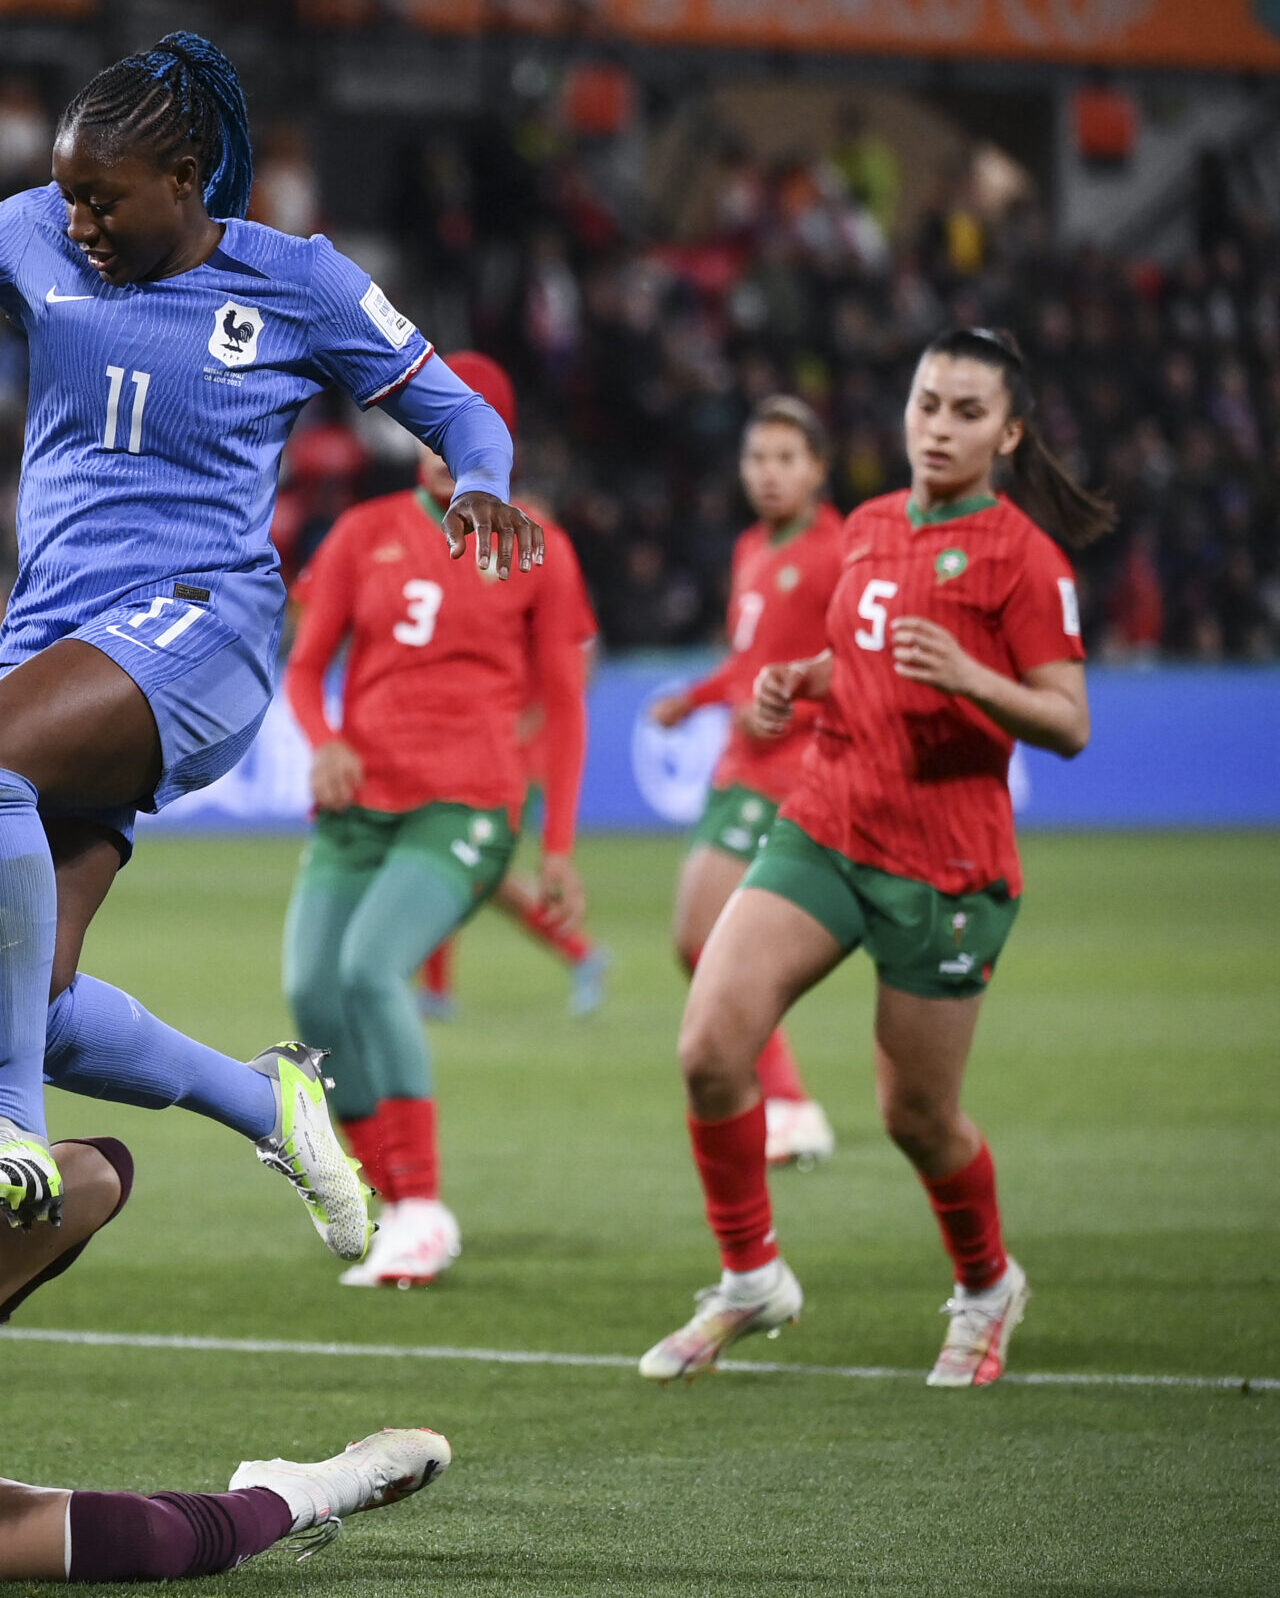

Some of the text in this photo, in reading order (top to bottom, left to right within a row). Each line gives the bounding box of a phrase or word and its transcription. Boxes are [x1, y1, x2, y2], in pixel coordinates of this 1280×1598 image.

[104, 365, 150, 453] 11
[127, 596, 207, 648] 11
[393, 578, 443, 647] 3
[854, 578, 898, 652] 5
